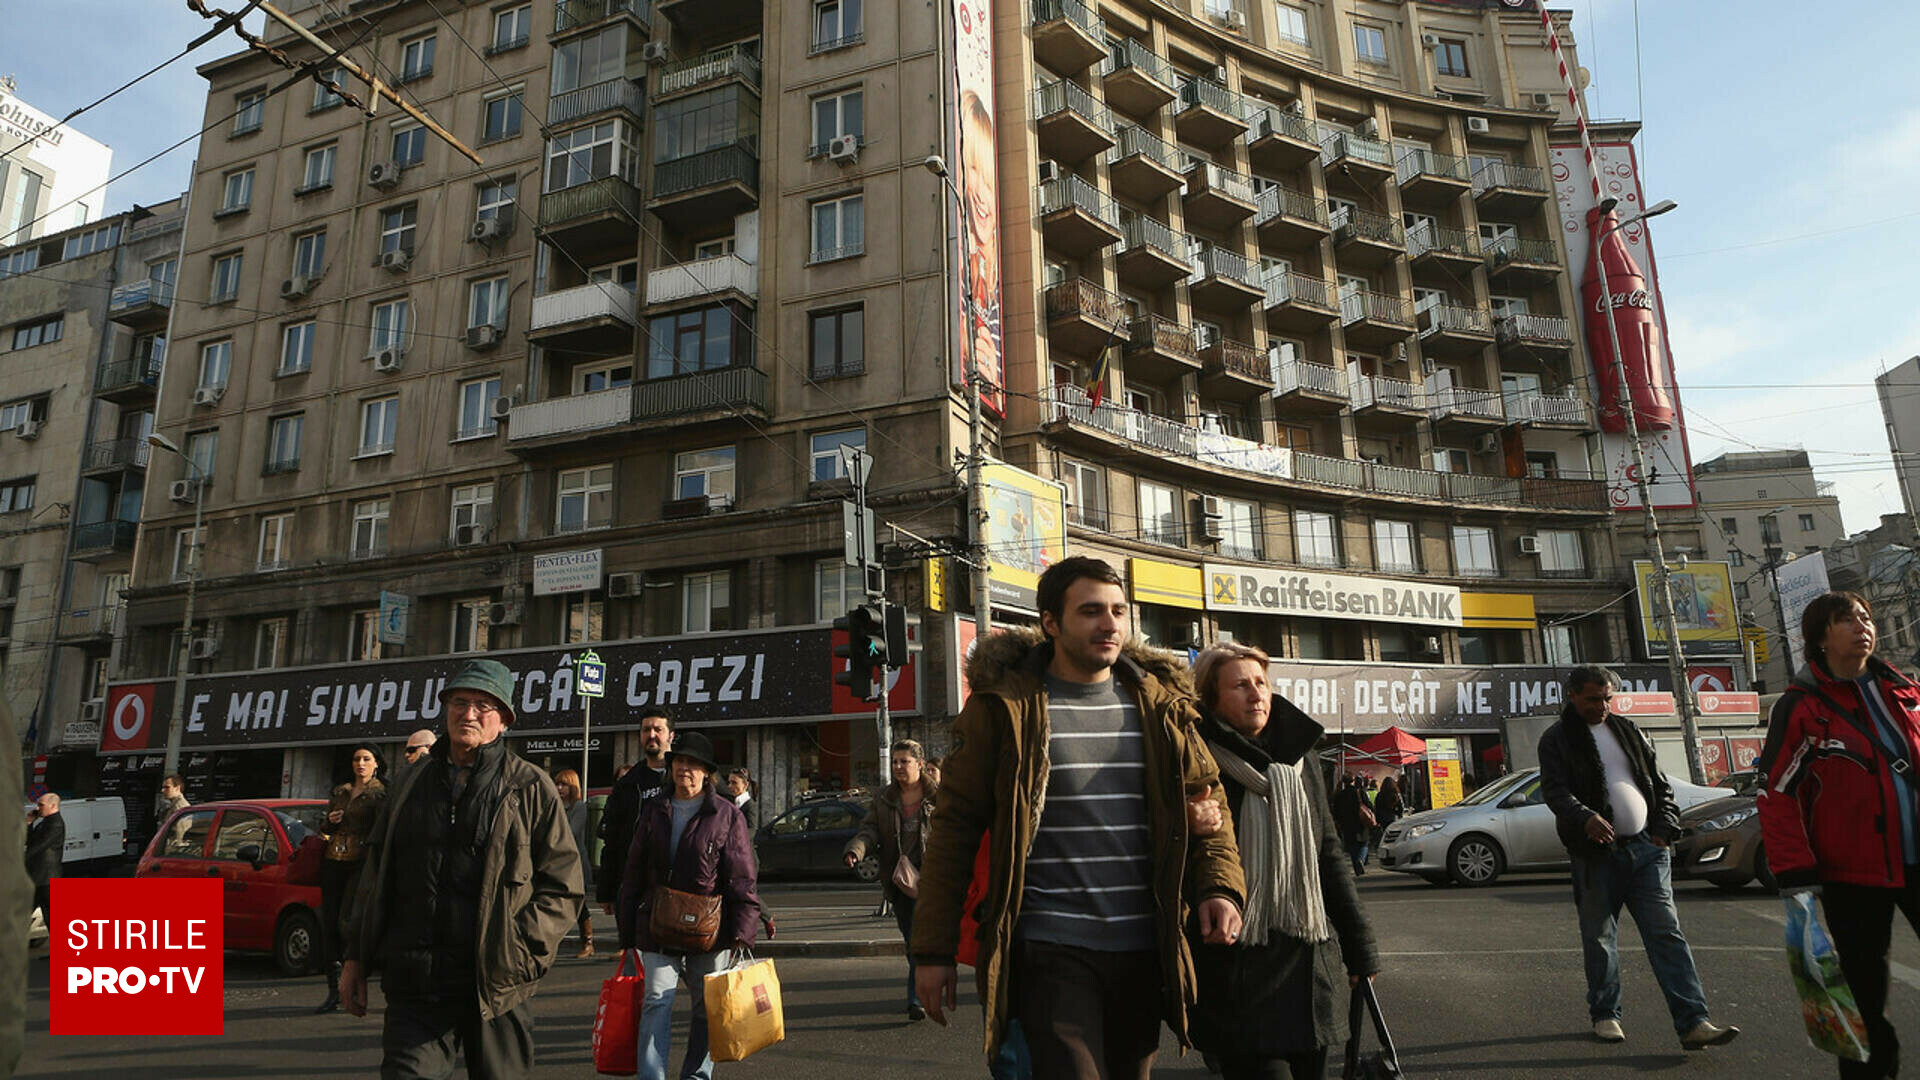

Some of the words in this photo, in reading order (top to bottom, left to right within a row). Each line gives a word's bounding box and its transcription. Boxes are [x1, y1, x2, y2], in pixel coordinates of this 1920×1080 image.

[7, 126, 40, 148] HOTL
[186, 694, 210, 732] E
[225, 689, 289, 730] MAI
[306, 677, 446, 726] SIMPLU
[626, 653, 766, 706] CREZI
[1354, 670, 1441, 715] DECÂT
[1457, 682, 1492, 714] NE
